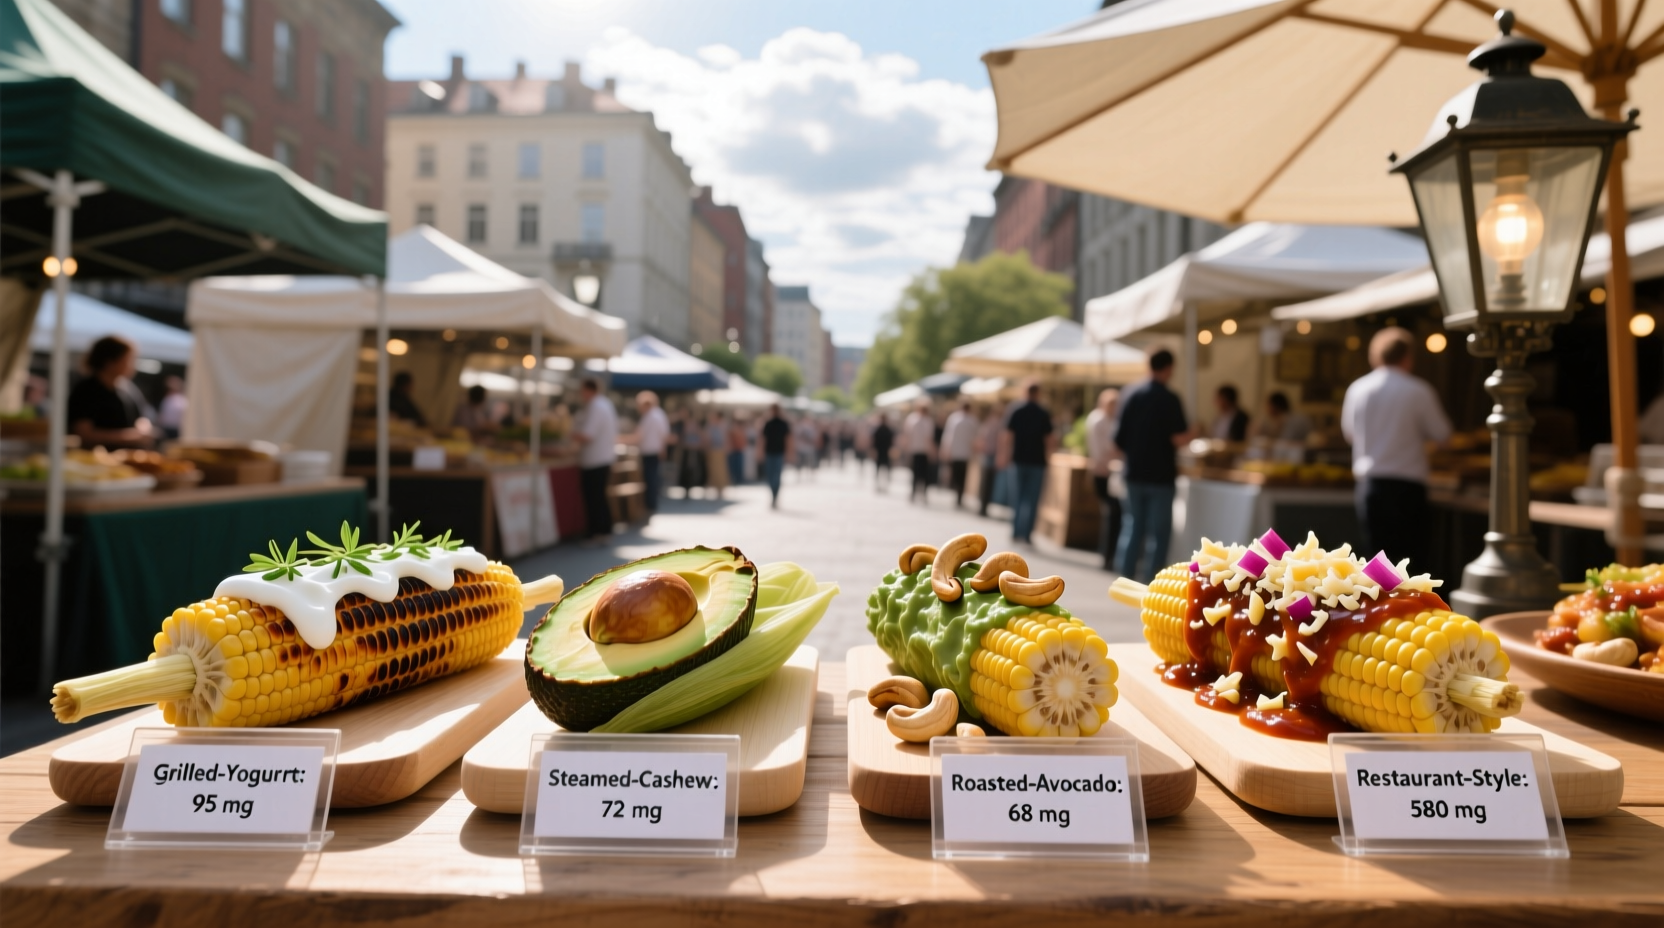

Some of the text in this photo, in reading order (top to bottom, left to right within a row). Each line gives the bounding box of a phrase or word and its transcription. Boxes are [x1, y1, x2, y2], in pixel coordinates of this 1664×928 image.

[153, 762, 306, 788] Grilled-Yogurrt:
[548, 768, 719, 790] Steamed-Cashew:
[951, 773, 1123, 794] Roasted-Avocado:
[1356, 768, 1529, 793] Restaurant-Style:
[192, 793, 255, 820] 95 mg
[601, 800, 663, 824] 72 mg
[1008, 803, 1071, 829] 68 mg
[1410, 799, 1487, 825] 580 mg
